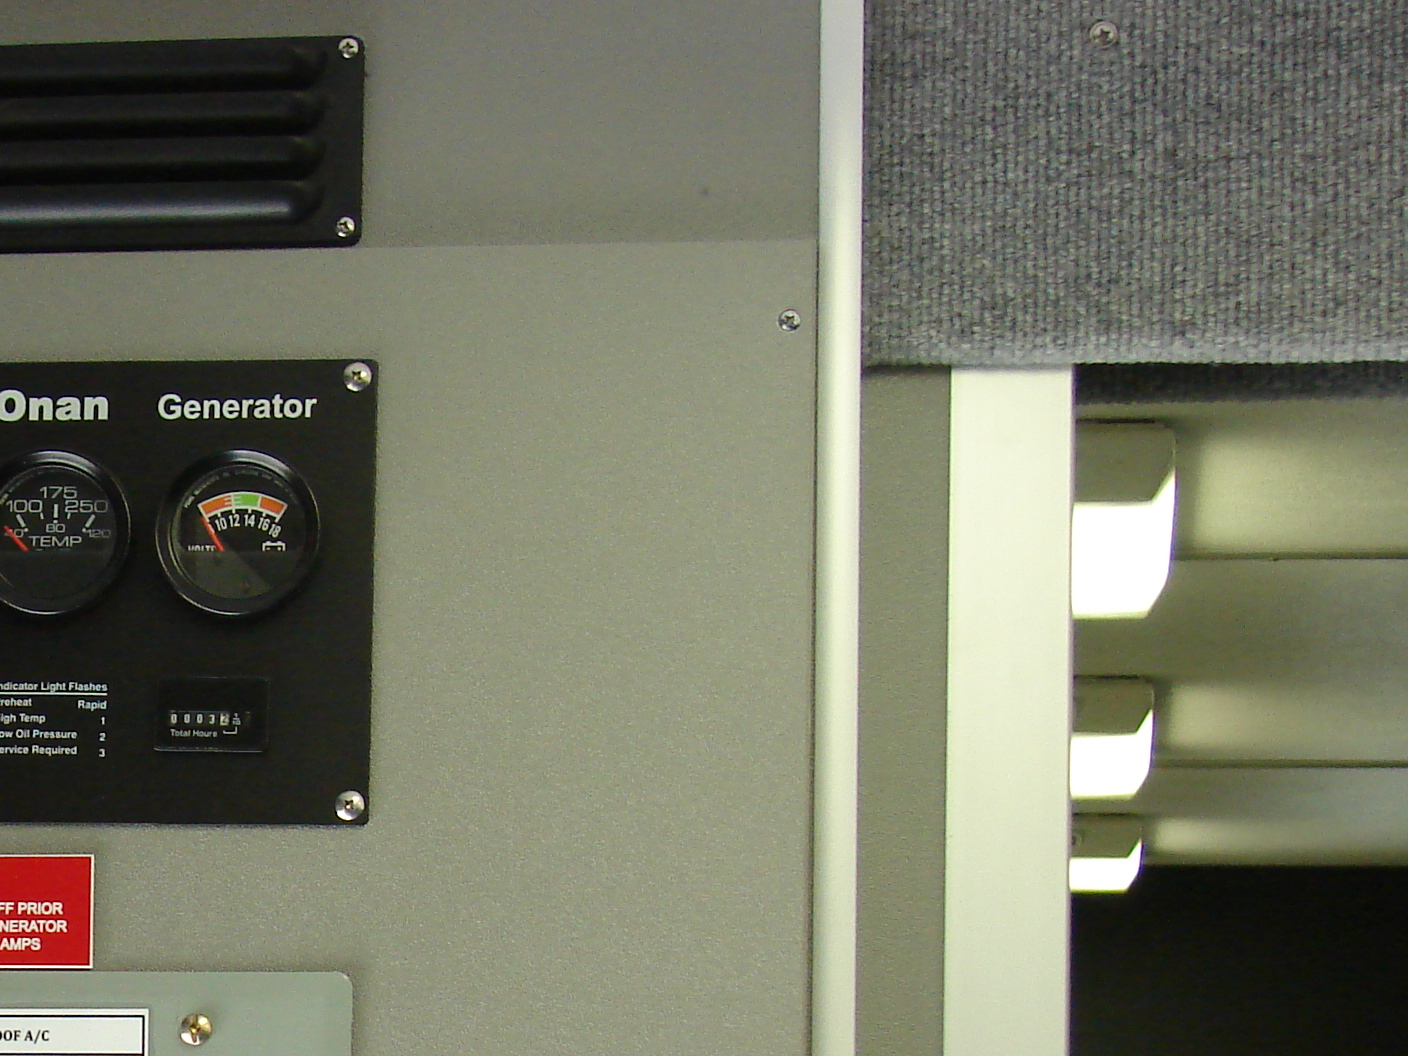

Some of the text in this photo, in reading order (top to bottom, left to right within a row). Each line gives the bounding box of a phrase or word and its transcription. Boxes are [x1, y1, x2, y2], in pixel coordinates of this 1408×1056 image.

[157, 393, 318, 420] Generator
[39, 486, 78, 499] 175
[5, 500, 108, 513] 100 250
[45, 524, 66, 533] 80
[214, 514, 282, 538] 10 12 14 16 18
[87, 529, 111, 538] 120
[28, 536, 82, 547] TEMP
[40, 681, 66, 692] Light
[68, 682, 108, 691] Flashes
[77, 700, 107, 711] Rapid
[19, 713, 46, 724] Temp
[100, 716, 106, 725] 1
[15, 729, 30, 738] Oil
[32, 729, 78, 739] Pressure
[99, 733, 106, 741] 2
[170, 729, 218, 738] Total Hours
[31, 744, 78, 756] Required
[99, 748, 106, 757] 3
[17, 902, 64, 915] PRIOR
[0, 937, 41, 951] AMPS
[24, 1030, 50, 1044] A/C
